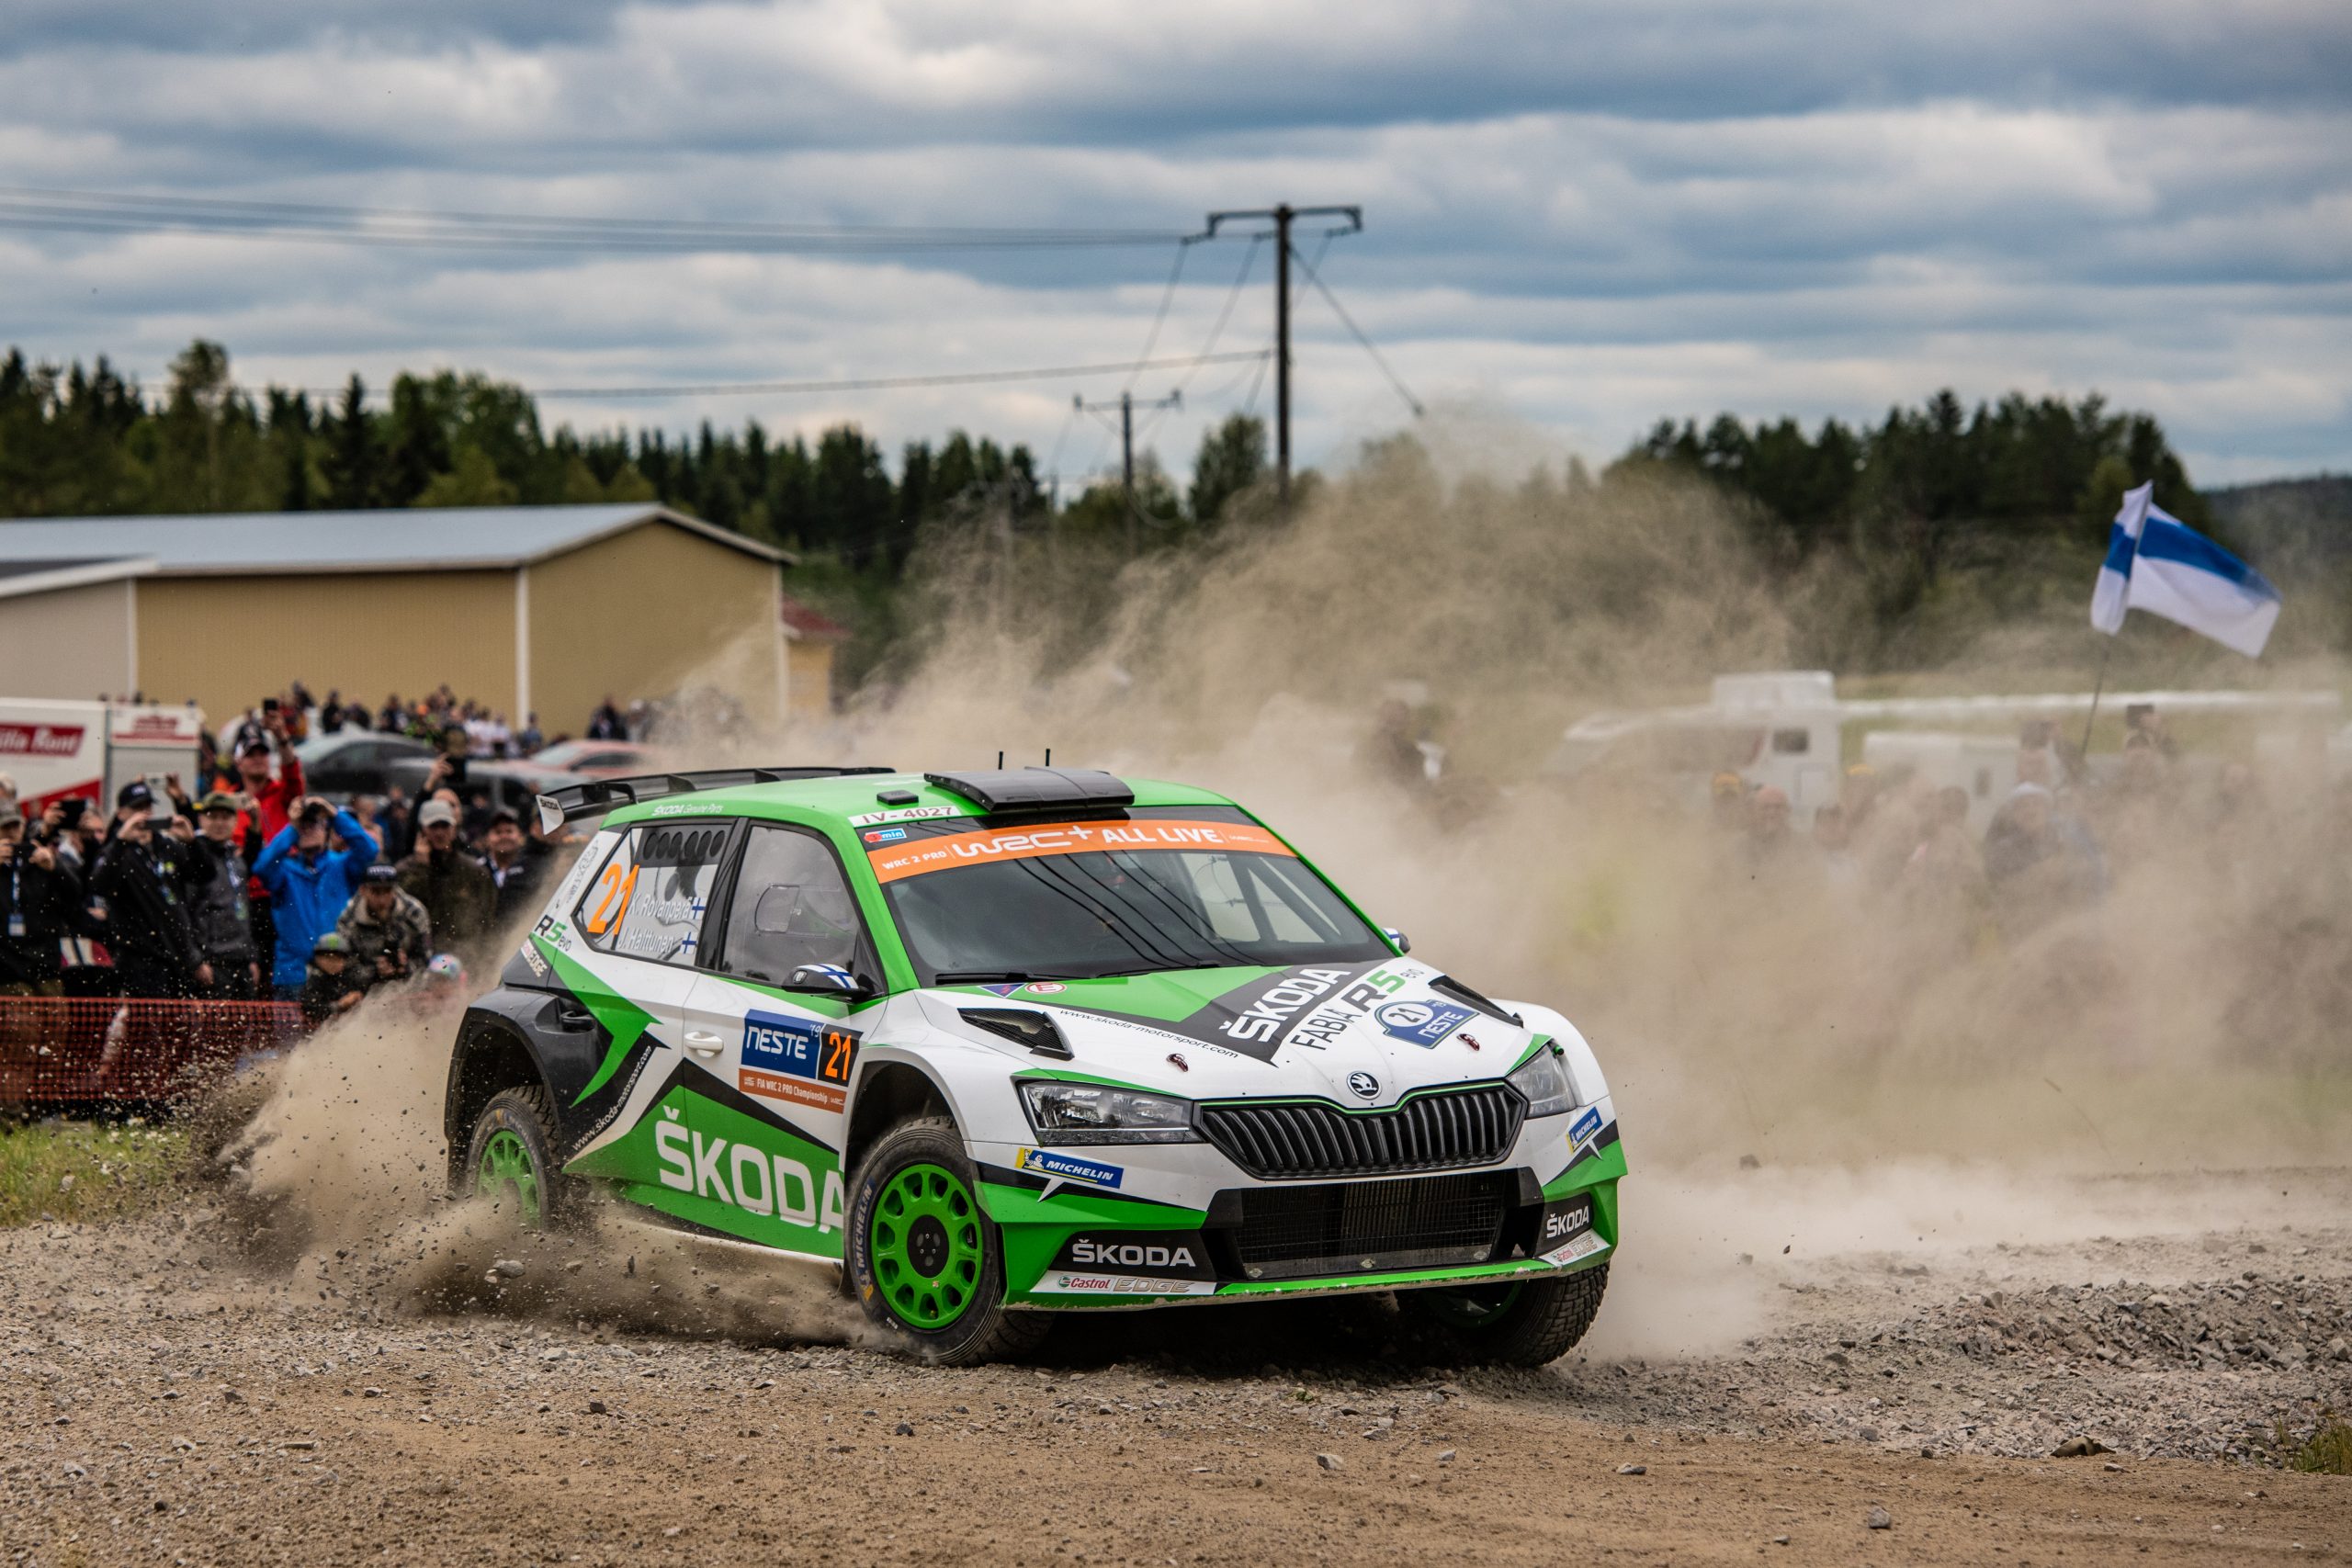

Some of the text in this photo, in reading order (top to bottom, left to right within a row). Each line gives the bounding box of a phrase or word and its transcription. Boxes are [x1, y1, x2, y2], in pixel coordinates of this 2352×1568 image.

[1102, 828, 1157, 843] ALL
[1157, 828, 1224, 843] LIVE
[882, 858, 910, 870] WRC
[922, 851, 947, 861] PRO
[586, 863, 640, 936] 21
[558, 935, 572, 953] evo
[1218, 968, 1352, 1043] ŠKODA
[1289, 1008, 1363, 1051] FABIA
[1340, 969, 1406, 1013] R5
[1388, 1008, 1427, 1023] 21
[1059, 1010, 1238, 1059] www.skoda-motorsport.com
[1417, 1010, 1464, 1039] NESTE
[746, 1025, 809, 1060] NESTE
[824, 1032, 853, 1081] 21
[756, 1078, 766, 1089] FIA
[766, 1080, 777, 1092] WRC
[777, 1082, 782, 1092] 2
[782, 1084, 793, 1095] PRO
[793, 1086, 828, 1105] Championship
[655, 1105, 844, 1235] ŠKODA
[1046, 1159, 1114, 1181] MICHELIN
[855, 1183, 873, 1269] MICHELIN
[1546, 1205, 1589, 1239] ŠKODA
[1072, 1238, 1196, 1268] ŠKODA
[1070, 1277, 1195, 1293] Castrol EDGE
